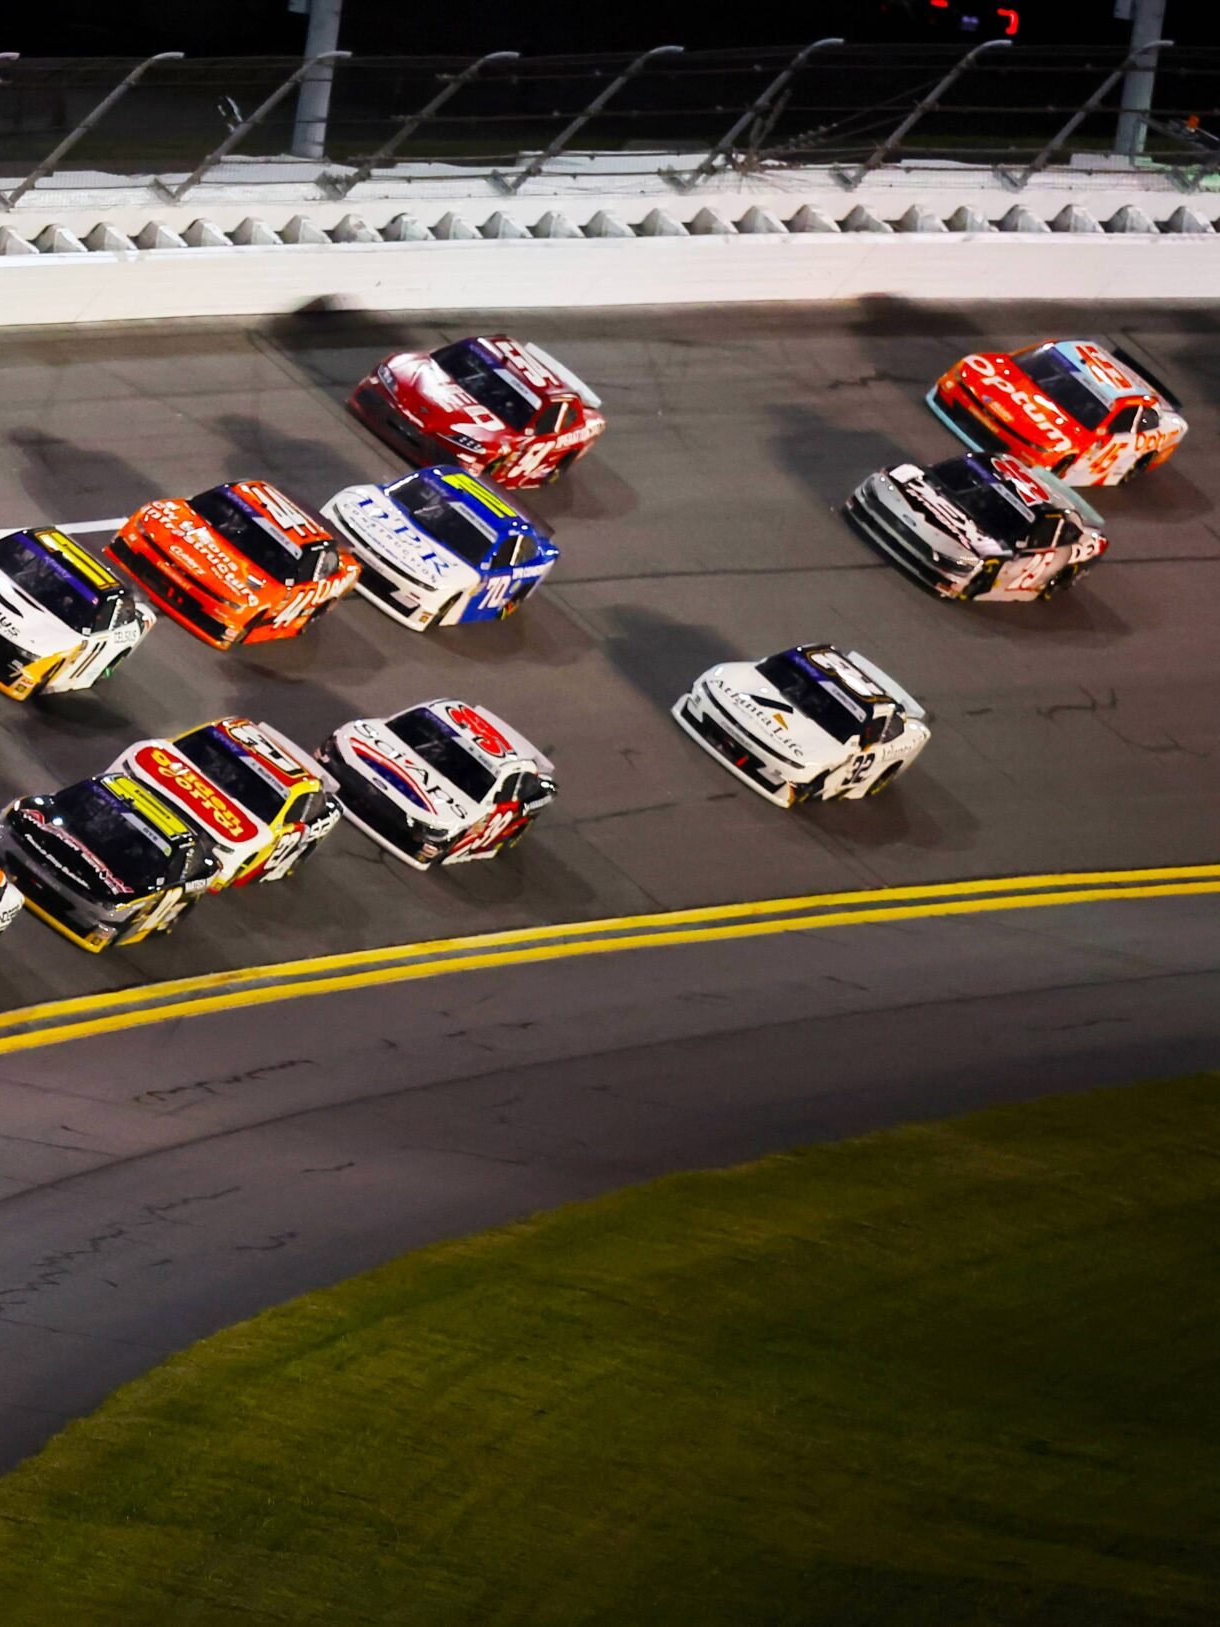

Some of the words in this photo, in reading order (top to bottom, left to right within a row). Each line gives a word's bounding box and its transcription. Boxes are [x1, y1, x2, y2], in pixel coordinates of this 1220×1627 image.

[964, 355, 1073, 452] Optum
[343, 503, 437, 583] CONSTRUCTION
[358, 498, 450, 576] DPR
[478, 576, 511, 610] 70
[710, 679, 773, 728] Atlanta
[773, 727, 804, 758] Life
[841, 752, 876, 785] 32
